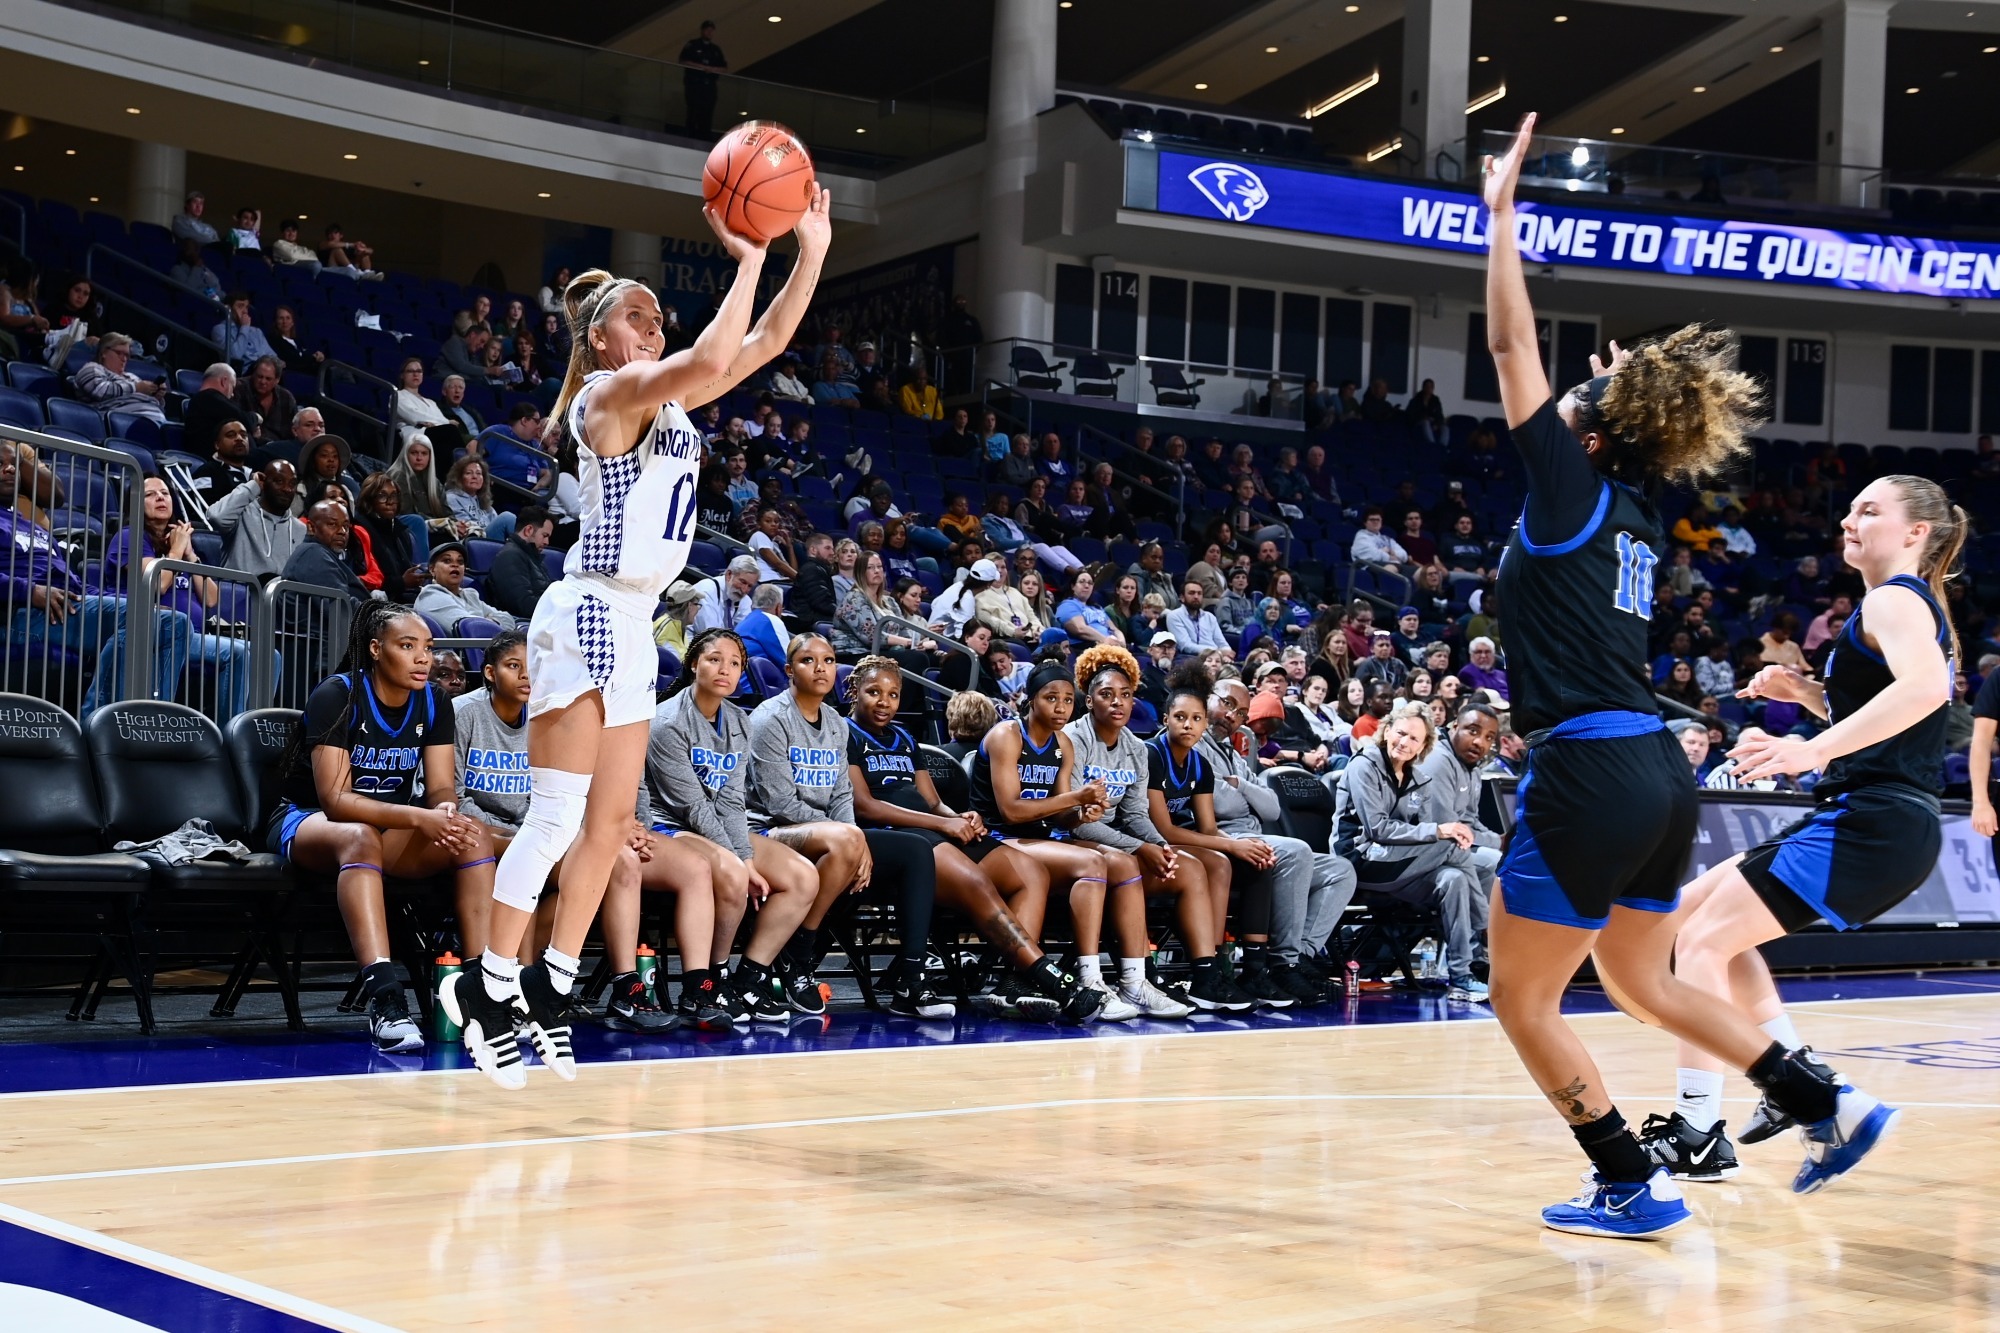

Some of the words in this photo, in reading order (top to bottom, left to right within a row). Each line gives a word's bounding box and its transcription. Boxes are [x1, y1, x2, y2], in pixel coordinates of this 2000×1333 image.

[1402, 197, 1602, 258] WELOME
[1609, 222, 1663, 263] TO
[1671, 227, 1753, 271] THE
[1757, 235, 1913, 285] QUBEIN
[1105, 275, 1139, 298] 114
[1790, 342, 1826, 364] 113
[653, 428, 690, 460] HIGH
[661, 471, 696, 542] 12
[13, 707, 62, 723] POINT
[113, 711, 155, 728] HIGH
[159, 714, 203, 729] POINT
[253, 718, 293, 734] HIGH
[0, 724, 63, 739] VERSITY
[118, 725, 205, 743] UNIVERSITY
[350, 744, 420, 771] BARTON
[468, 747, 530, 772] BARTO
[864, 754, 915, 774] BARTO
[464, 769, 532, 795] BASKETBA
